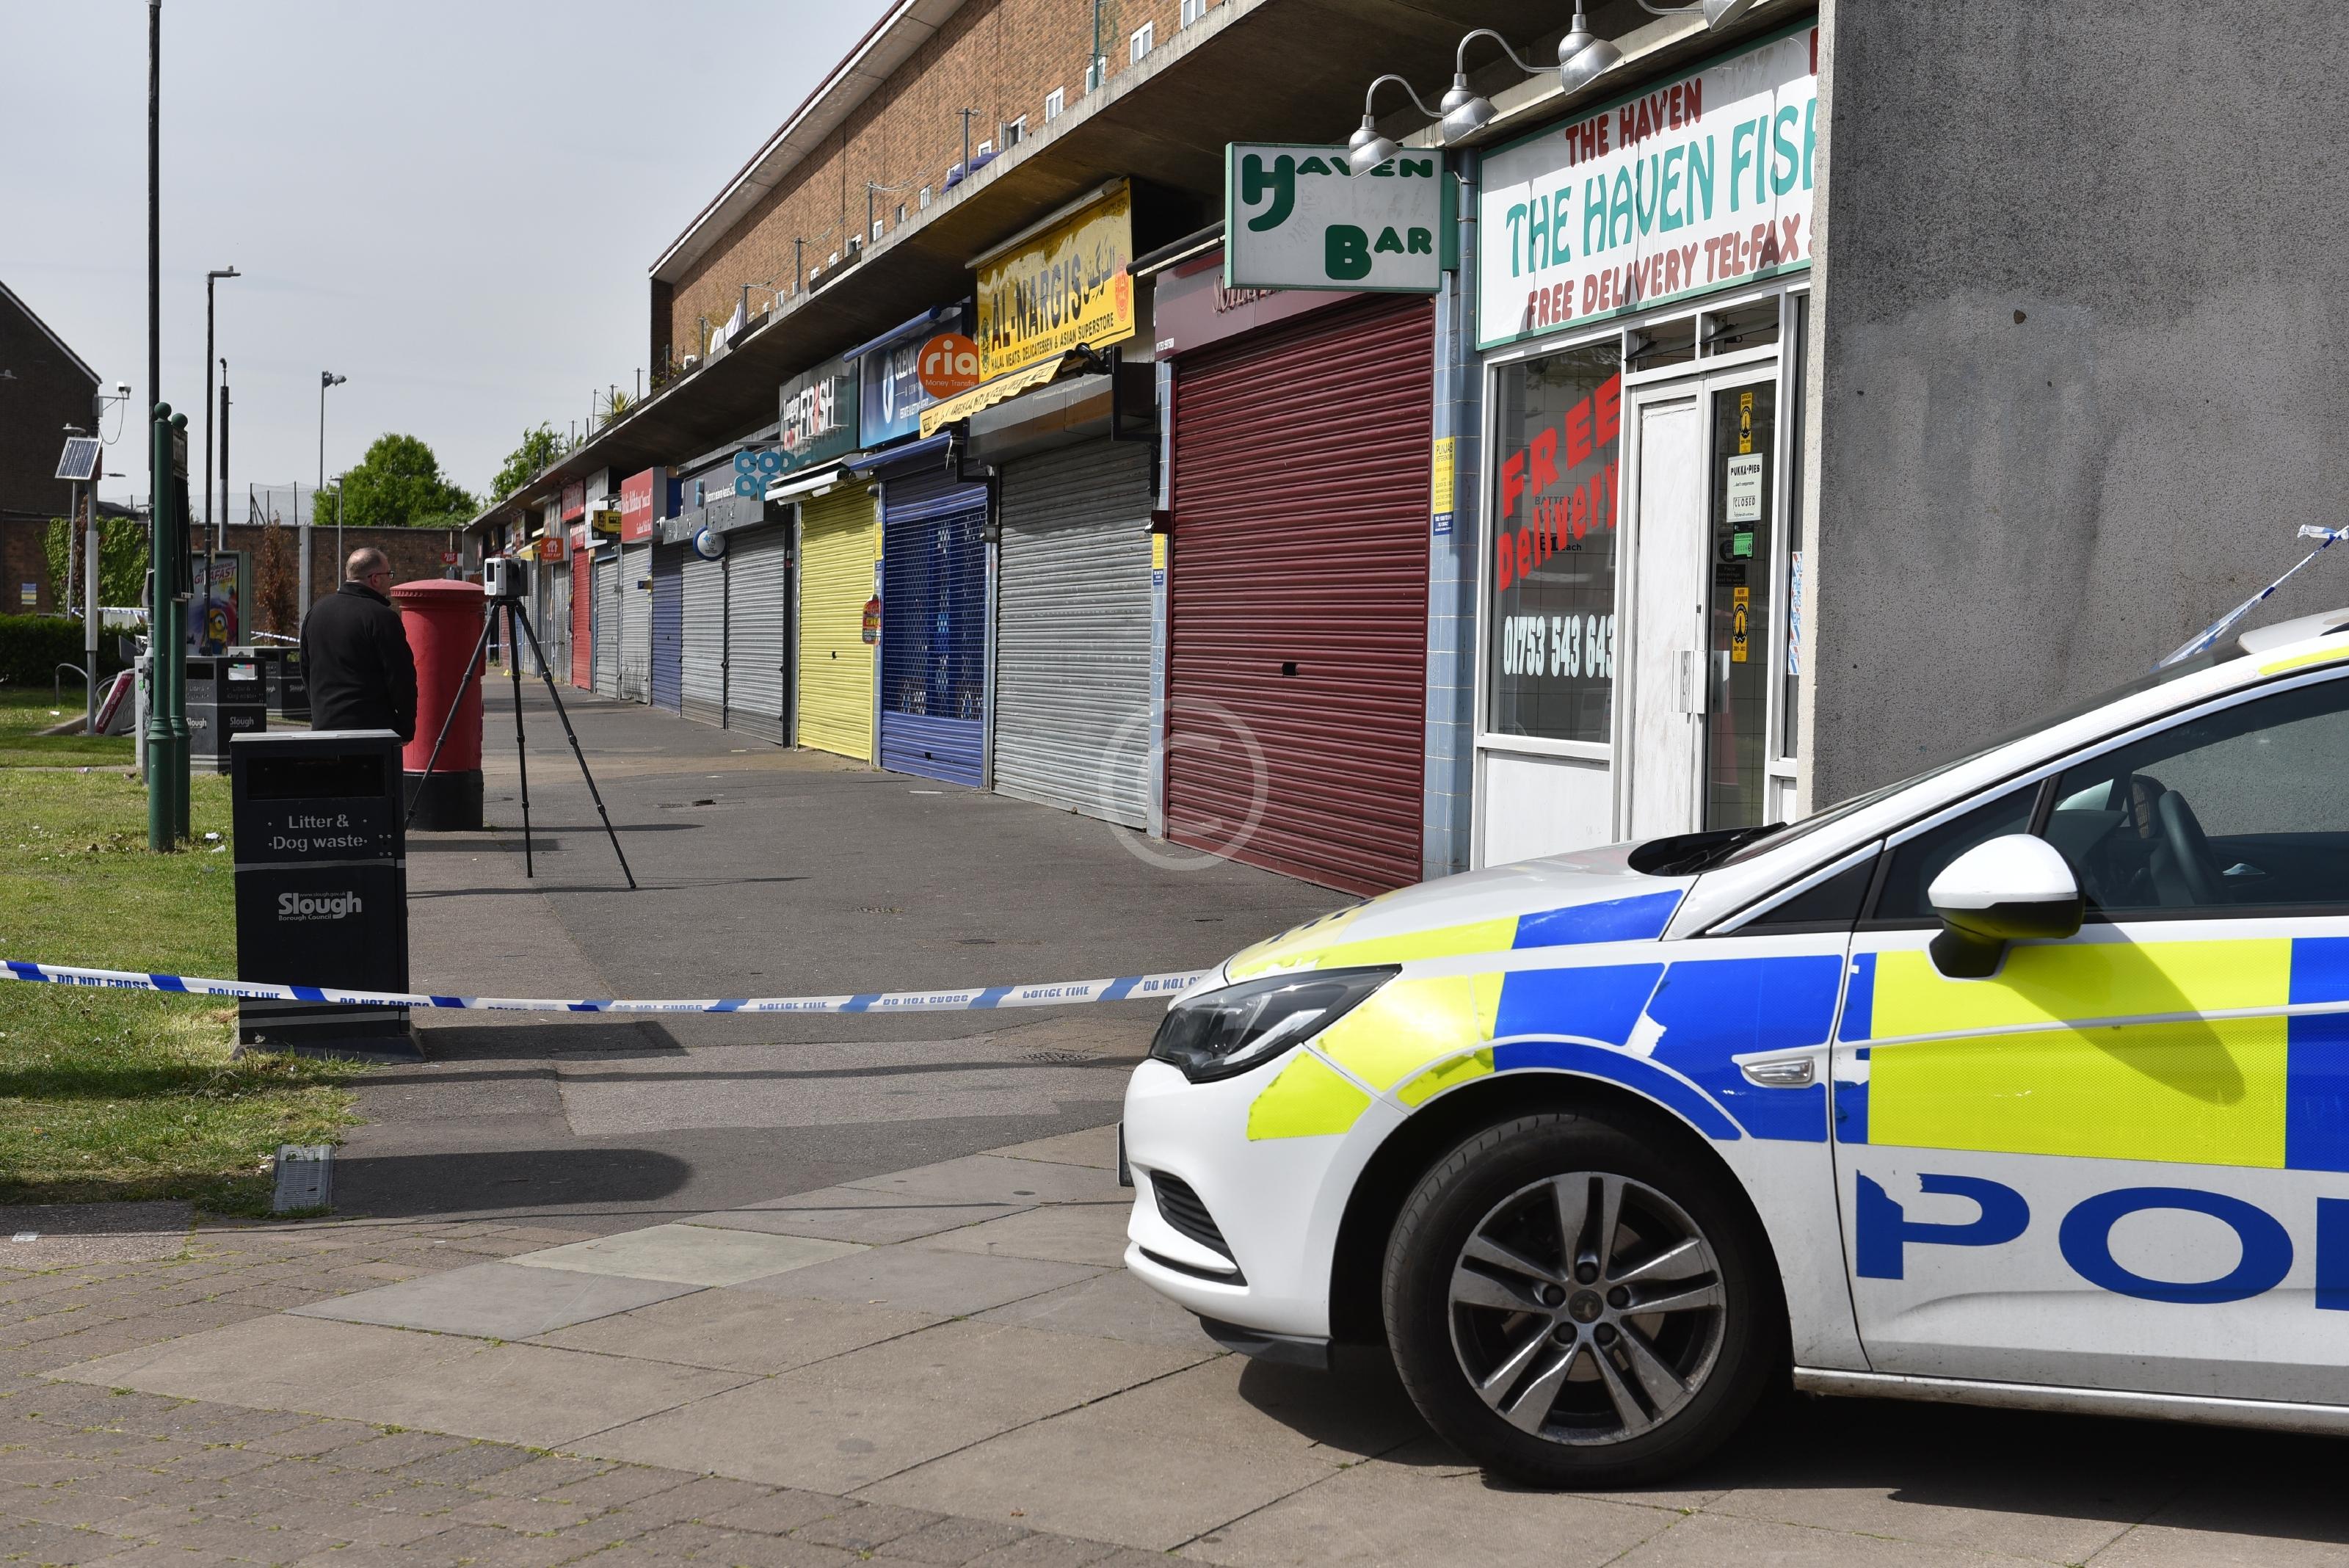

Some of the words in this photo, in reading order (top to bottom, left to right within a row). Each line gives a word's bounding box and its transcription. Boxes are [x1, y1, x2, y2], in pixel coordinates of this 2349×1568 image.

[1566, 115, 1608, 167] THE
[1619, 77, 1702, 149] HAVEN
[1506, 185, 1572, 278] THE
[1583, 134, 1715, 256] HAVEN
[1325, 225, 1433, 280] BAR
[991, 253, 1082, 352] AL-NARGIS
[1527, 280, 1574, 330] FREE
[1583, 242, 1697, 317] DELIVERY
[926, 340, 978, 375] ria
[991, 356, 1004, 371] HALAL
[1006, 350, 1021, 366] MEATS,
[1023, 339, 1053, 360] DELICATESSEN
[1055, 335, 1059, 349] &
[1060, 330, 1077, 347] ASIAN
[1078, 312, 1114, 340] SUPERSTORE
[896, 344, 916, 380] GLENN
[926, 380, 948, 388] Money
[951, 380, 975, 388] Transfe
[1437, 442, 1453, 454] PUNJAB
[1502, 372, 1621, 518] FREE
[1735, 498, 1755, 507] CLOSED
[1503, 616, 1546, 677] 01753
[1550, 614, 1580, 678] 543
[1586, 614, 1615, 679] 643
[230, 716, 254, 727] Slough
[288, 816, 333, 829] Litter
[336, 814, 349, 827] &
[273, 836, 308, 852] Dog
[313, 834, 364, 849] waste
[278, 891, 362, 919] Slough
[79, 976, 101, 987] NOT
[1856, 1169, 2349, 1311] PO
